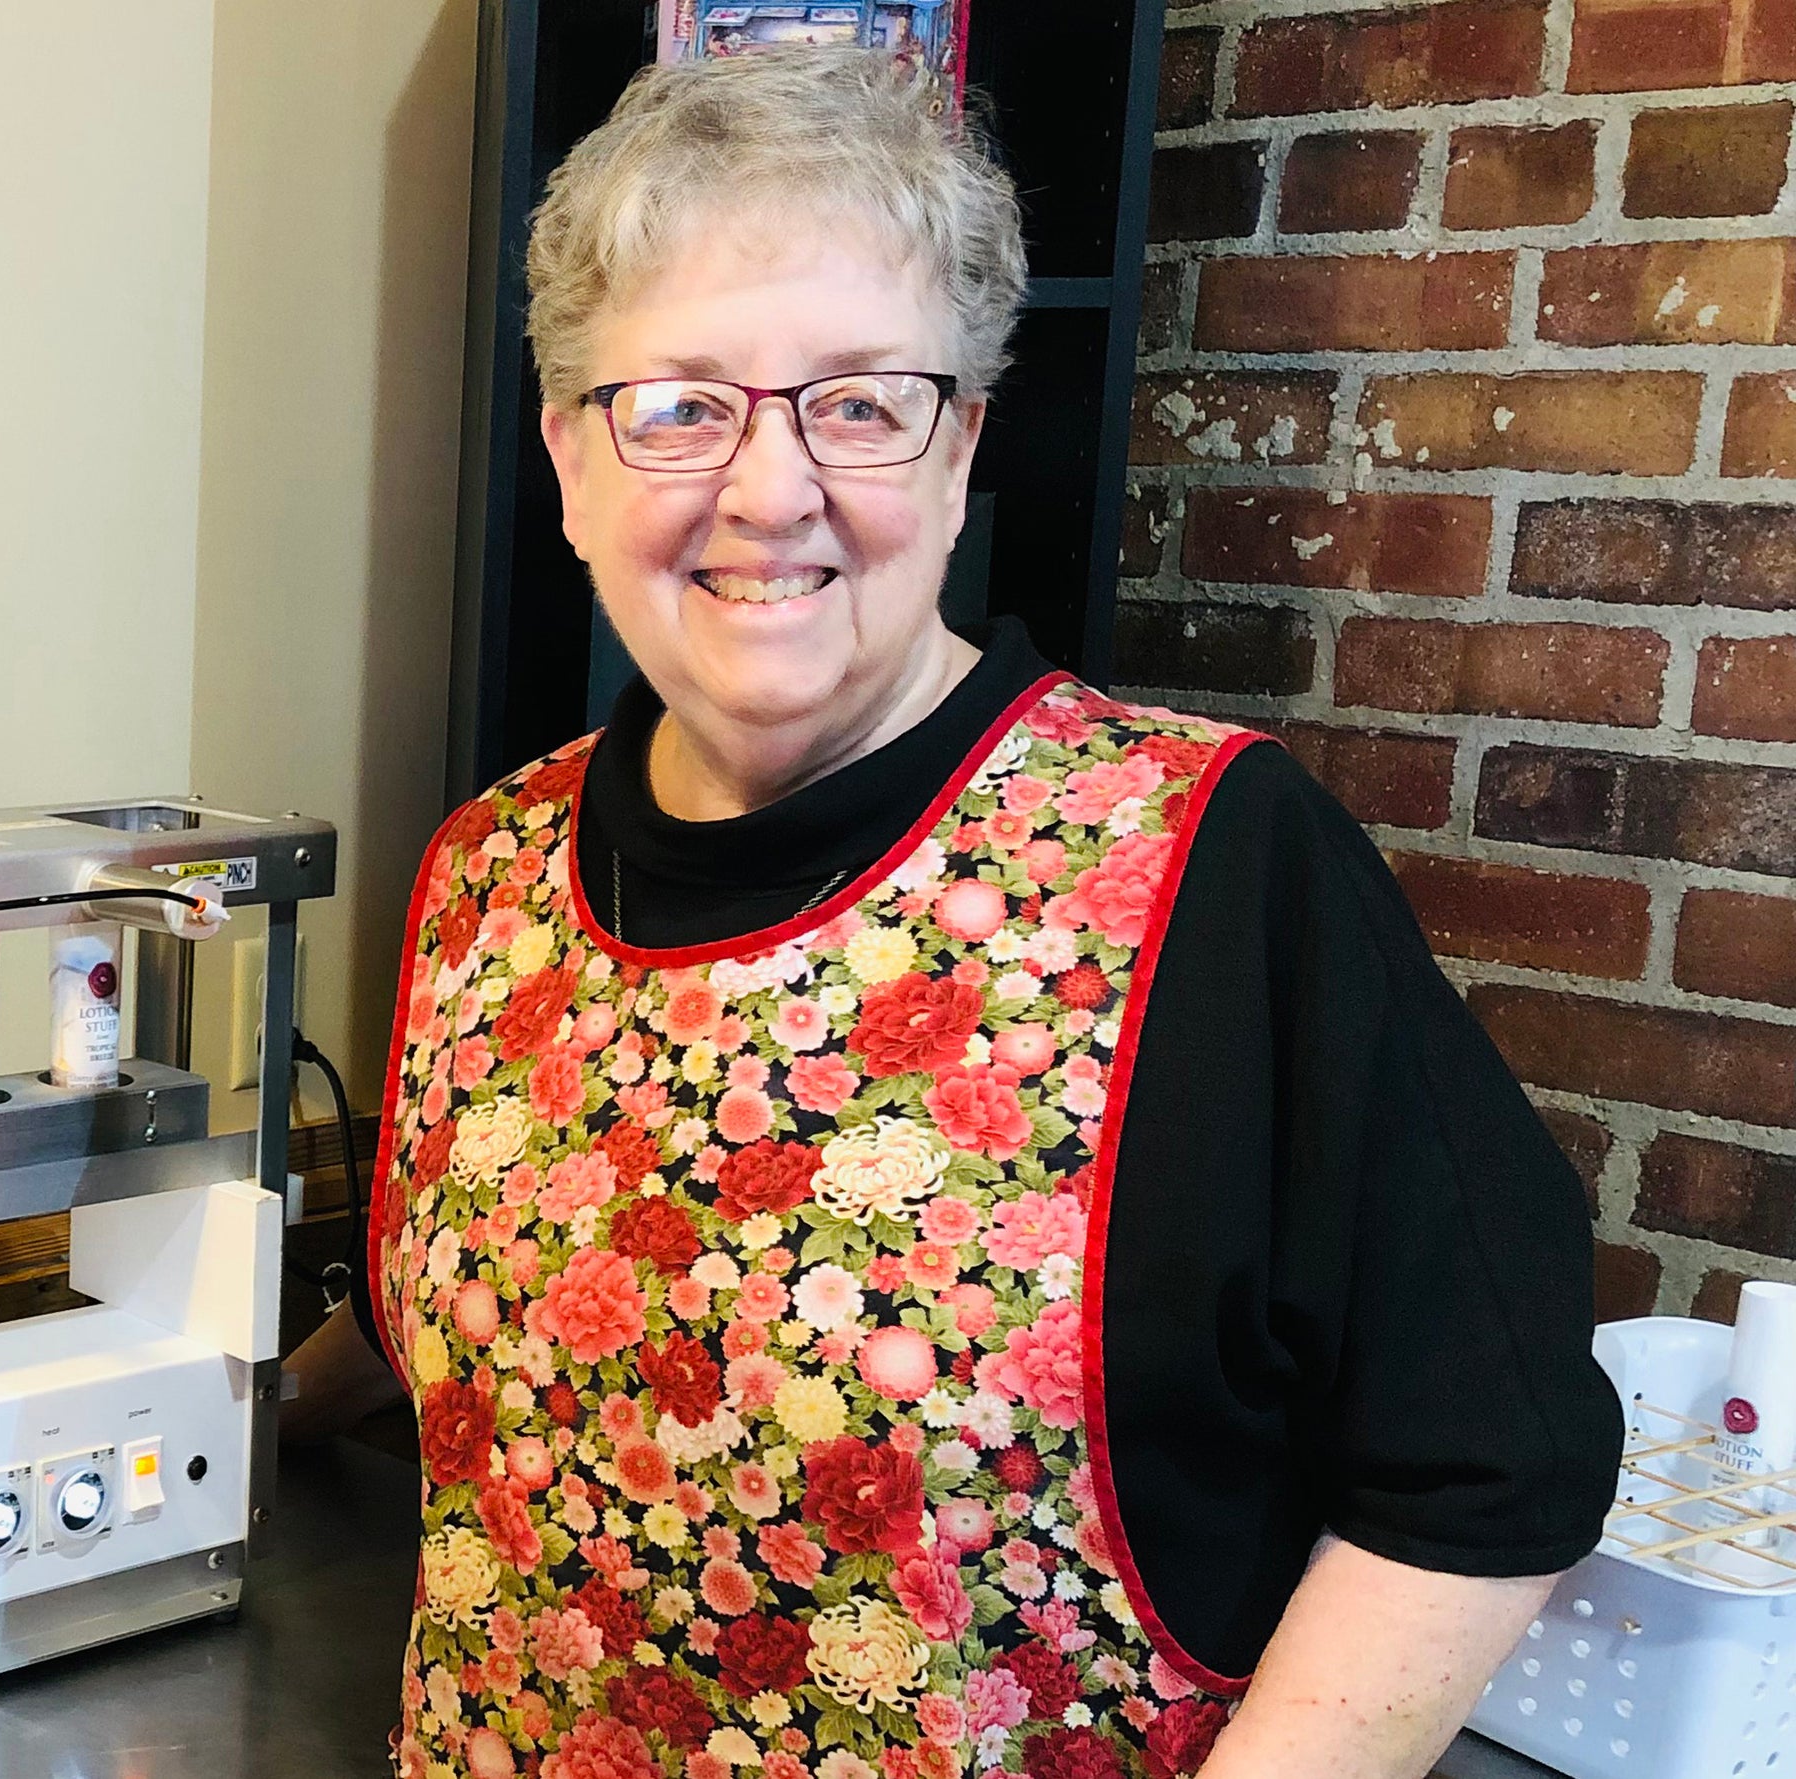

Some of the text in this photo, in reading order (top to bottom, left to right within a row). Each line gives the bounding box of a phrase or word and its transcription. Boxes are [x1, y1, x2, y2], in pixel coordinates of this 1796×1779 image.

[127, 1407, 153, 1419] power
[42, 1426, 61, 1437] heat
[1713, 1438, 1763, 1459] OTION
